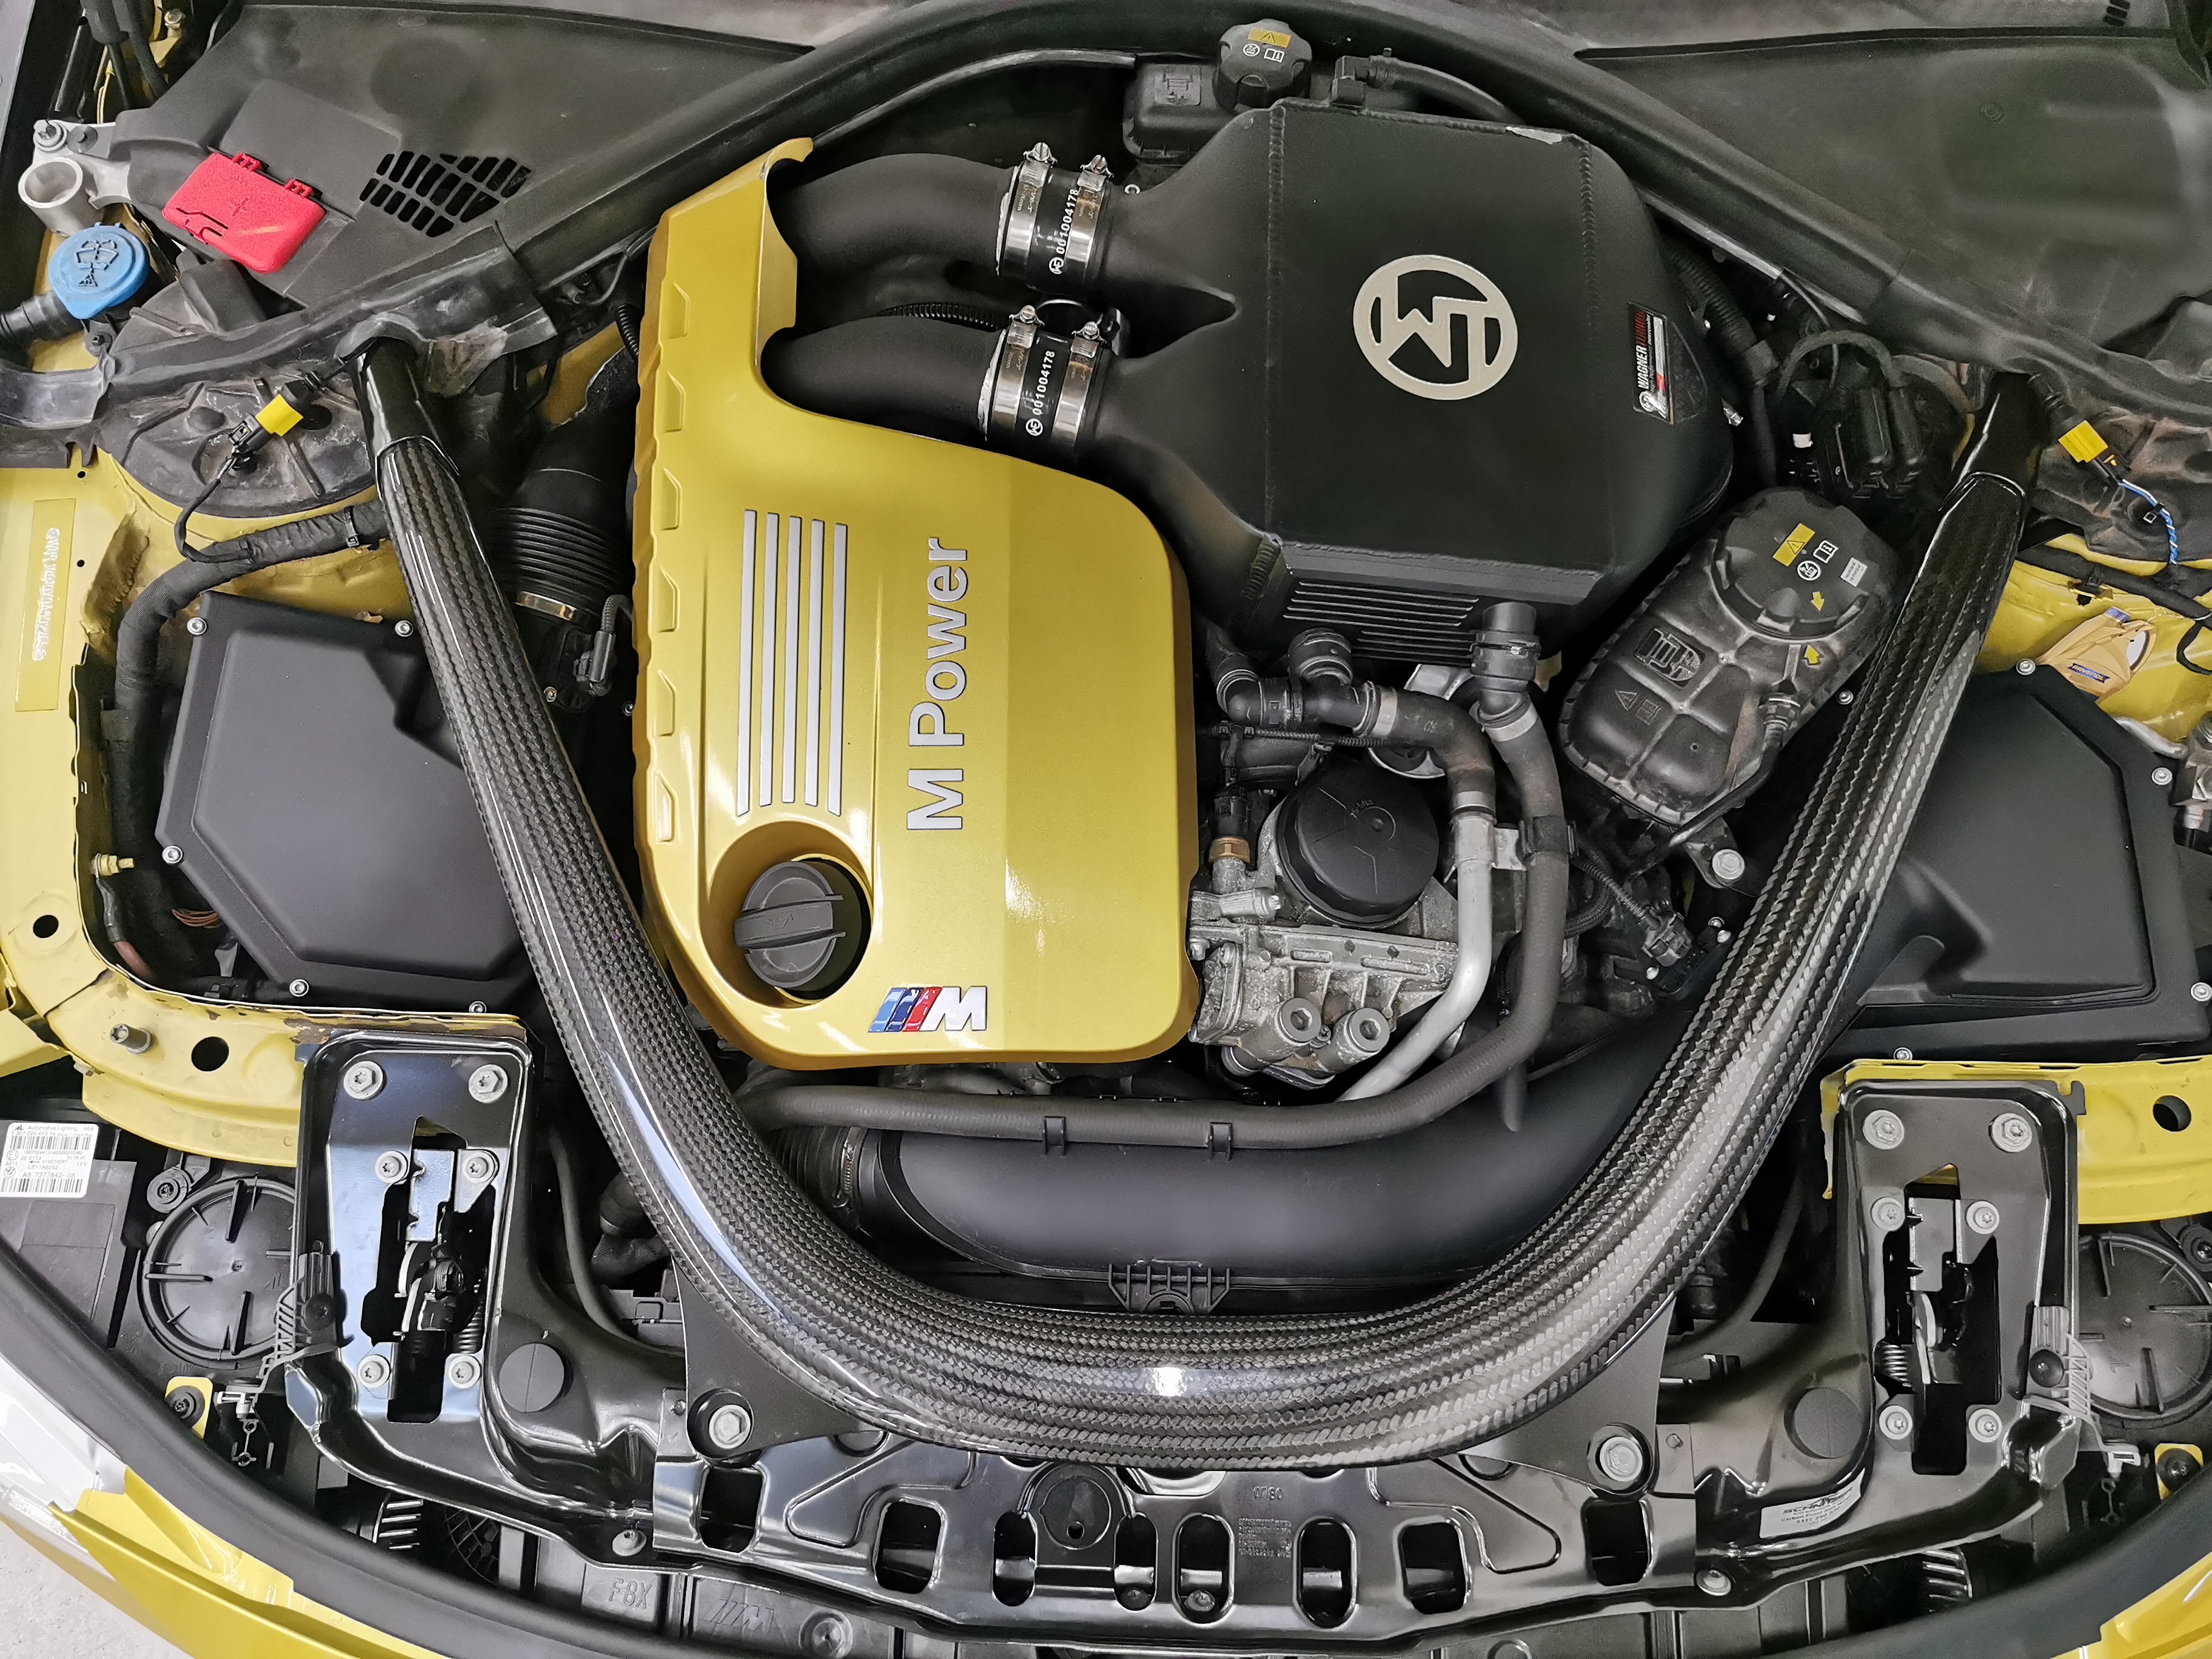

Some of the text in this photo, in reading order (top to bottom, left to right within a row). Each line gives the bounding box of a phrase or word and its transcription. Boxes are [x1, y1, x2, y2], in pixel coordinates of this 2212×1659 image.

[1056, 189, 1079, 255] 001004178
[1032, 350, 1056, 416] 001004178
[906, 537, 968, 830] M Power
[608, 1577, 652, 1610] F8X
